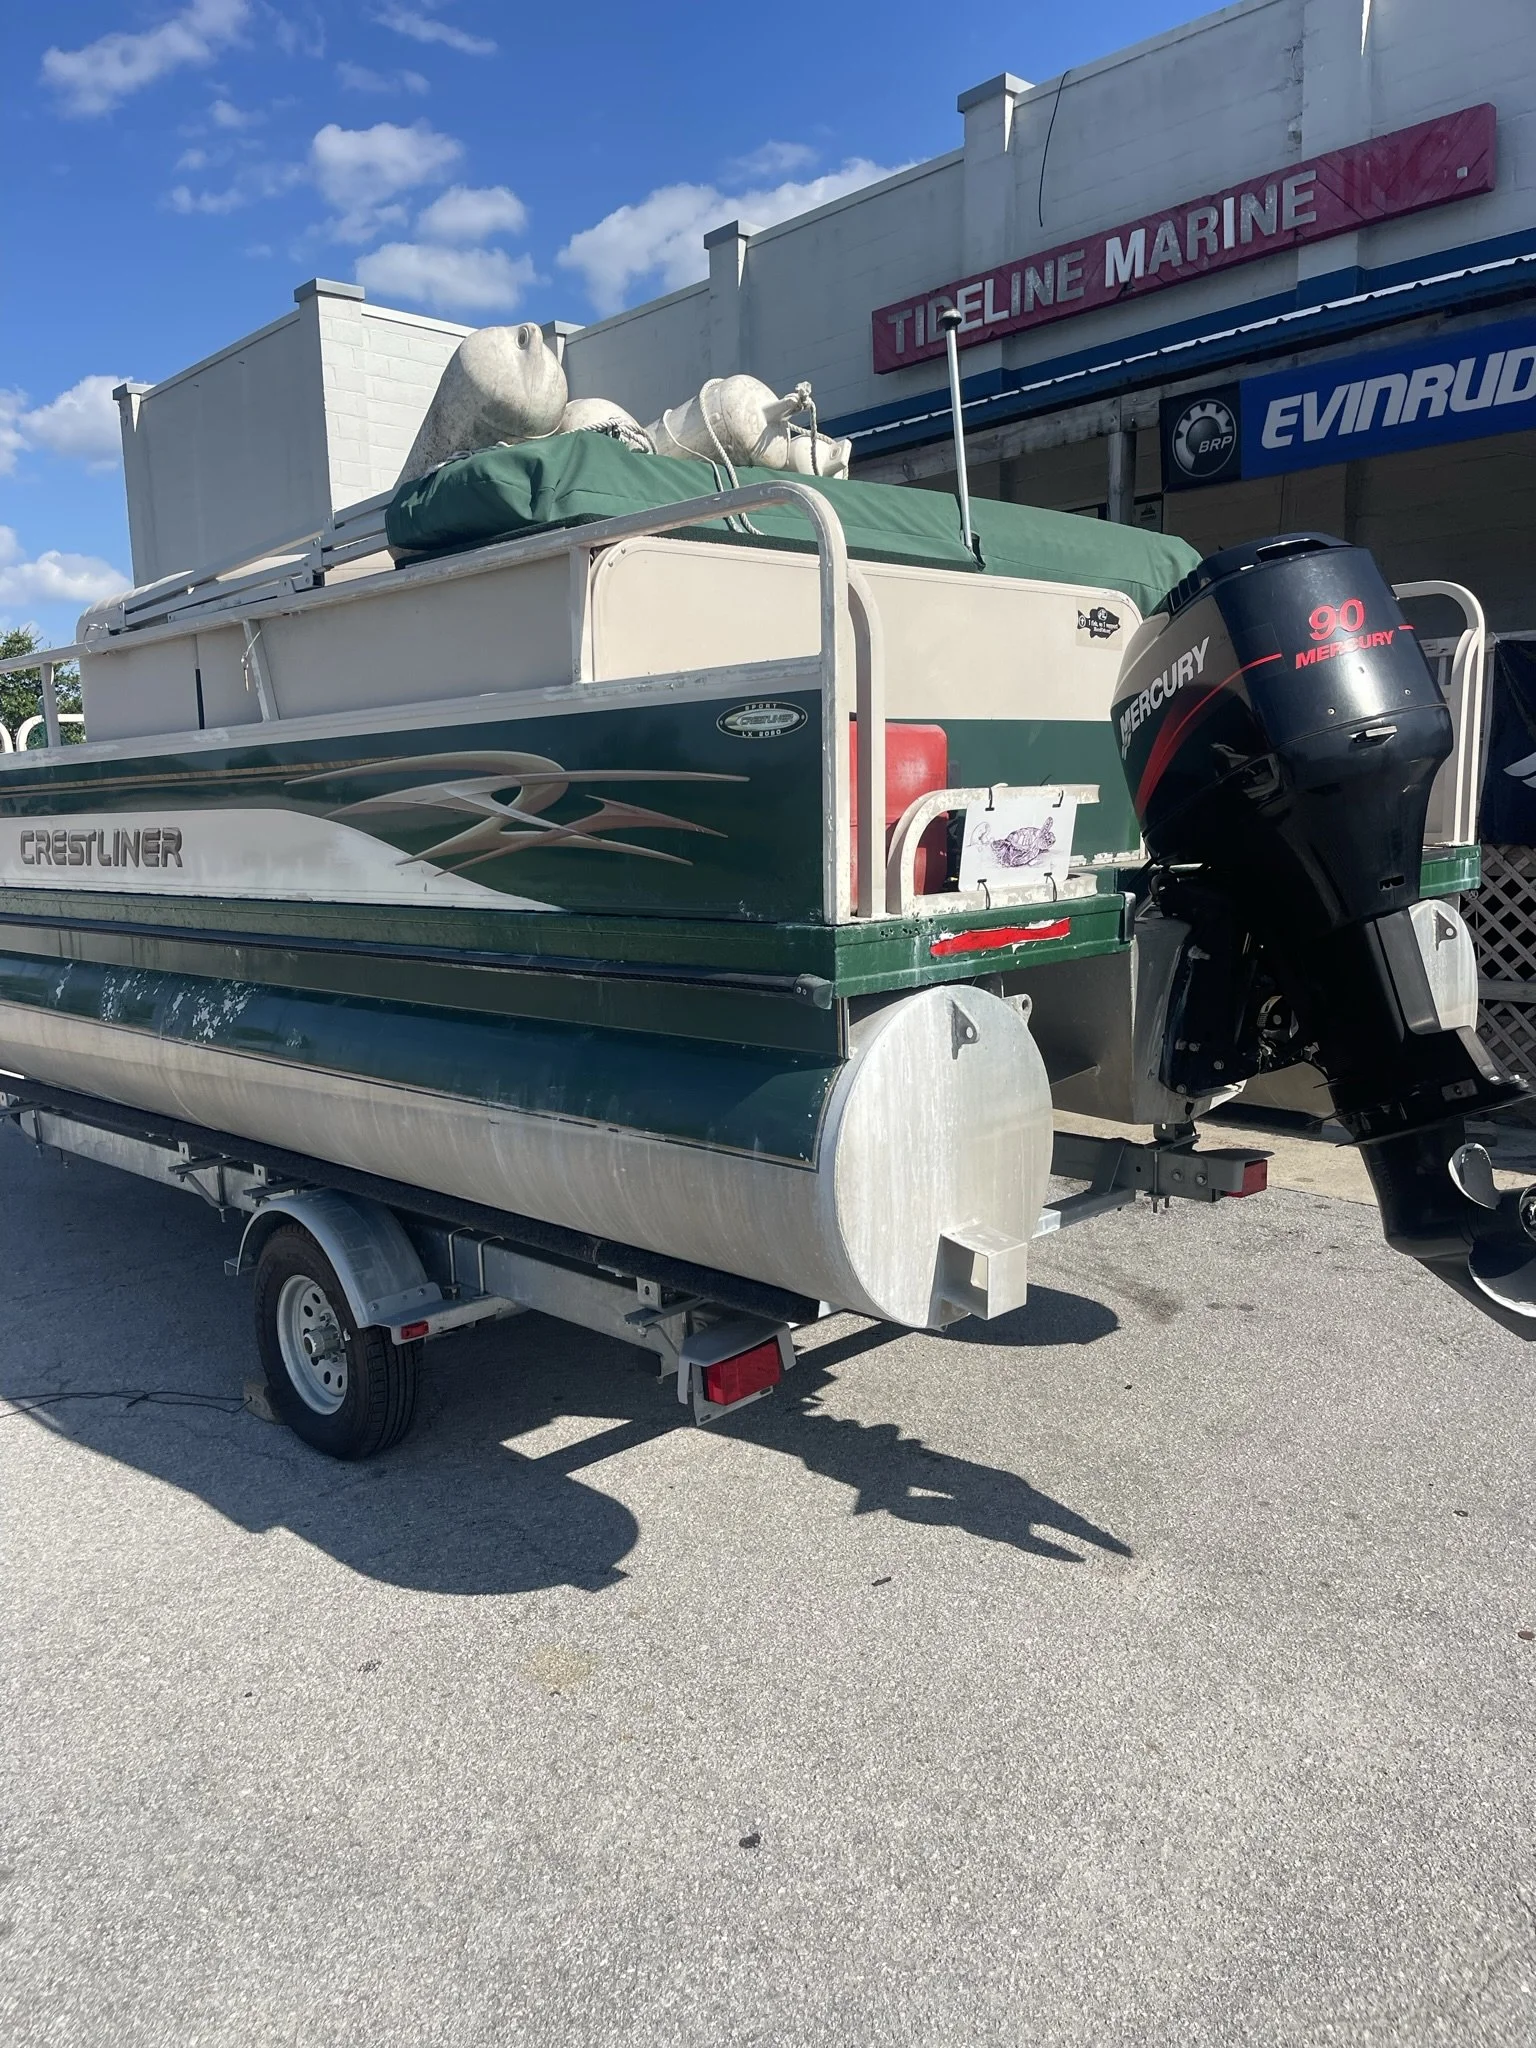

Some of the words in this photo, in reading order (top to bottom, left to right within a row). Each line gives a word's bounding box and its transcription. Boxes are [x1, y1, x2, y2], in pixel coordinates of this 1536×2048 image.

[887, 249, 1085, 354] TIDELINE
[1105, 169, 1317, 288] MARINE
[1199, 435, 1233, 454] BRP
[1308, 597, 1366, 641] 90
[1295, 630, 1395, 669] MERCURY
[1120, 636, 1209, 760] MERCURY
[20, 827, 183, 868] CRESTLINER
